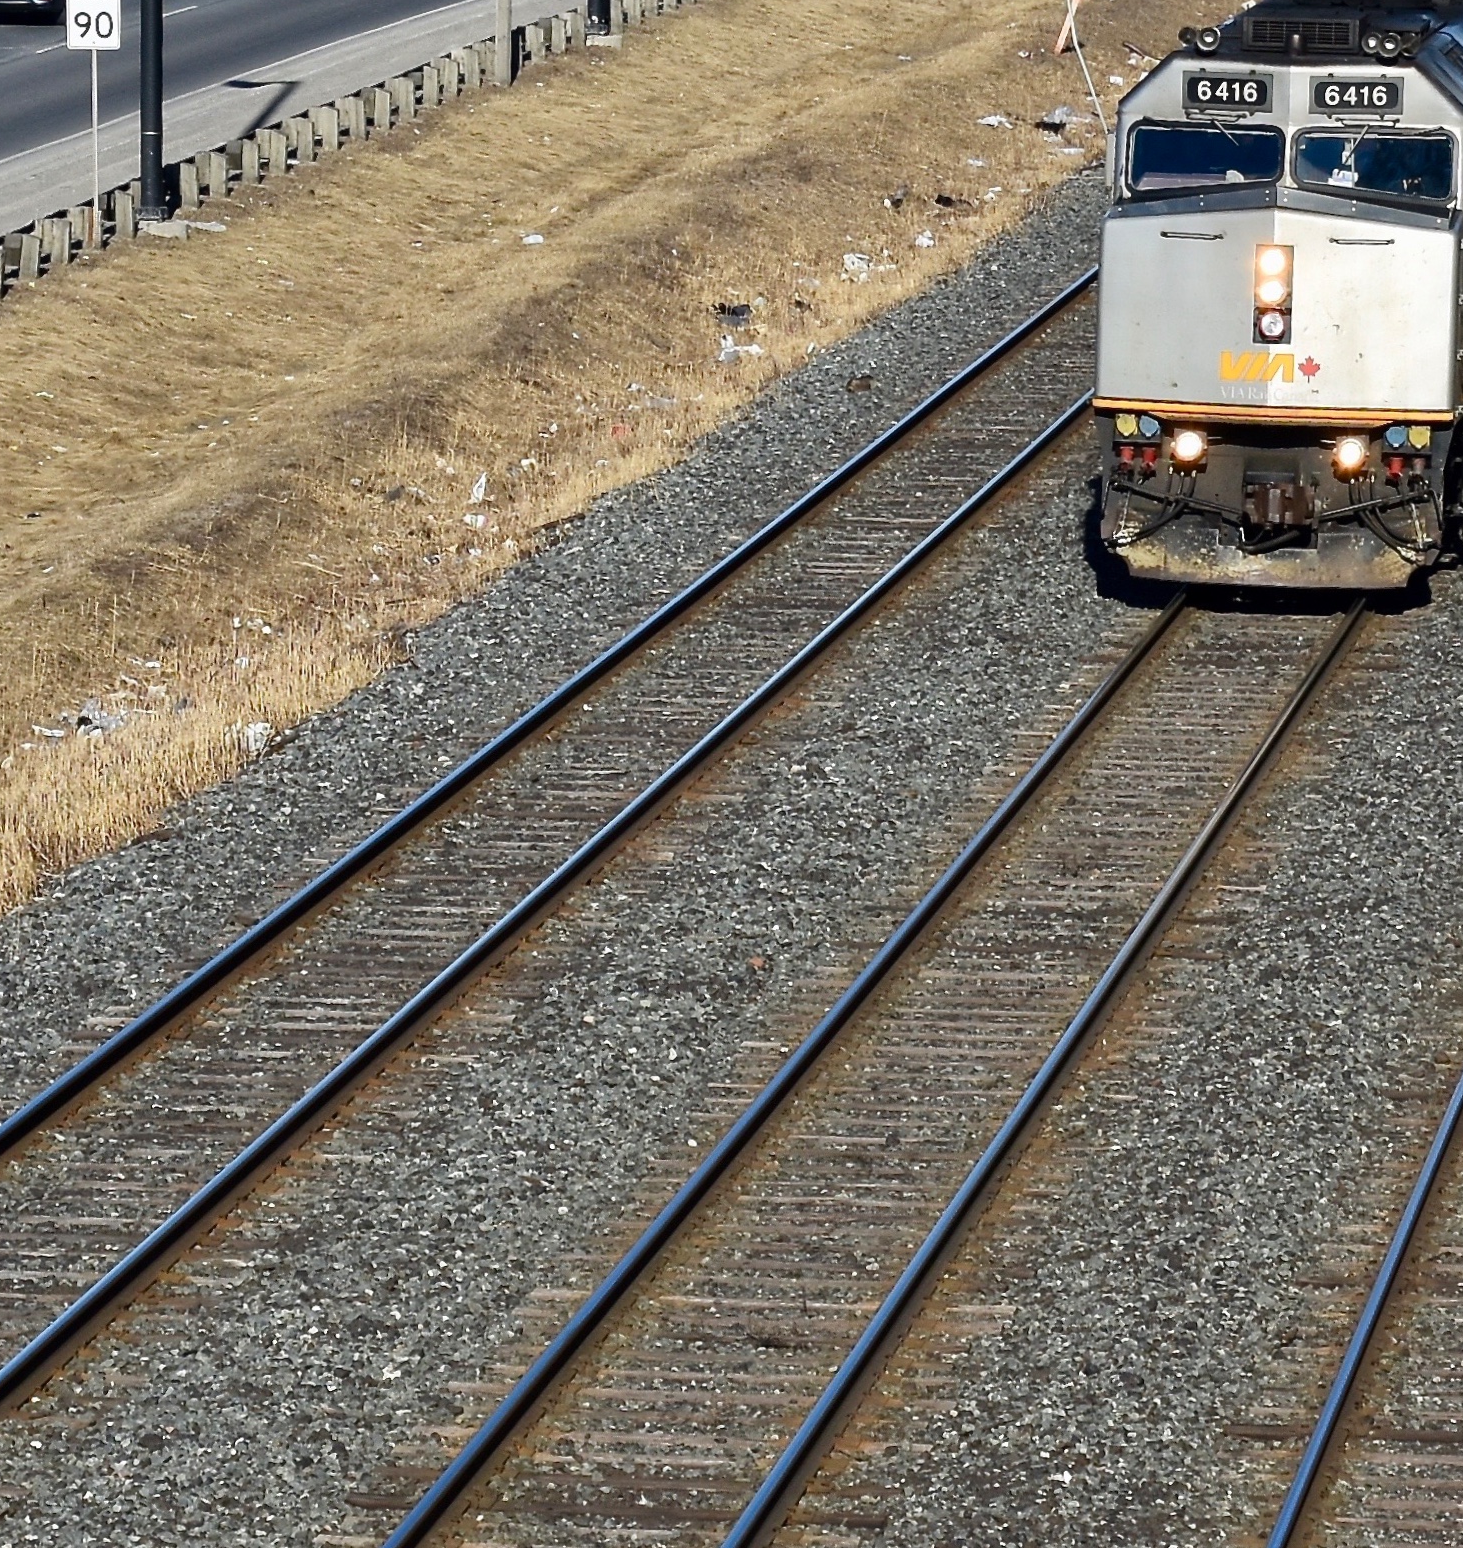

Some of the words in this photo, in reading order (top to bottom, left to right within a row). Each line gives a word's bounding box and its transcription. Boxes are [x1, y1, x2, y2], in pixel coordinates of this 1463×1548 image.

[74, 11, 114, 39] 90
[1197, 80, 1258, 103] 6416
[1324, 85, 1387, 106] 6416
[1220, 350, 1294, 383] VIA
[1220, 385, 1245, 399] VIA
